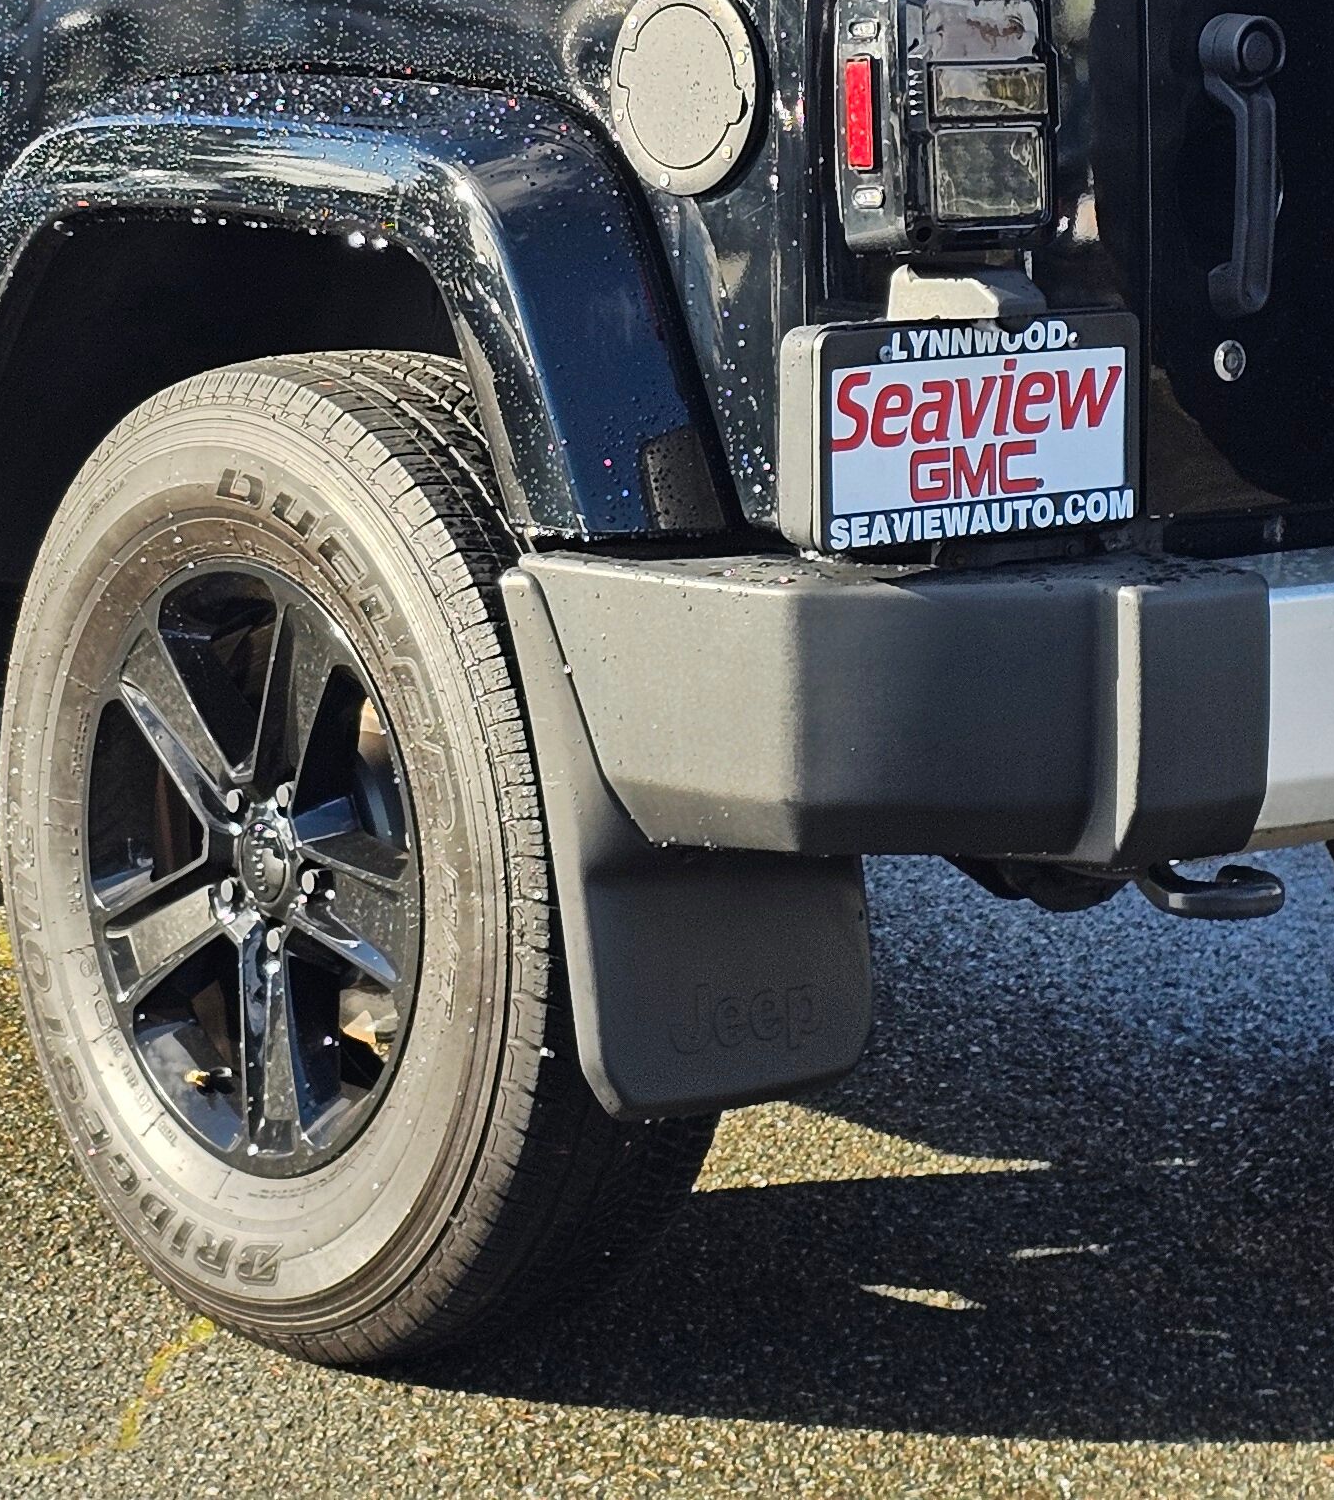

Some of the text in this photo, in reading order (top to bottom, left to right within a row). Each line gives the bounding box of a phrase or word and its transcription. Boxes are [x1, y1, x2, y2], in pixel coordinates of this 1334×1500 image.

[890, 320, 1068, 361] LYNNWOOD
[832, 359, 1122, 452] Seaview
[910, 439, 1038, 503] GMC
[830, 489, 1134, 551] SEAVIEWAUTO.COM
